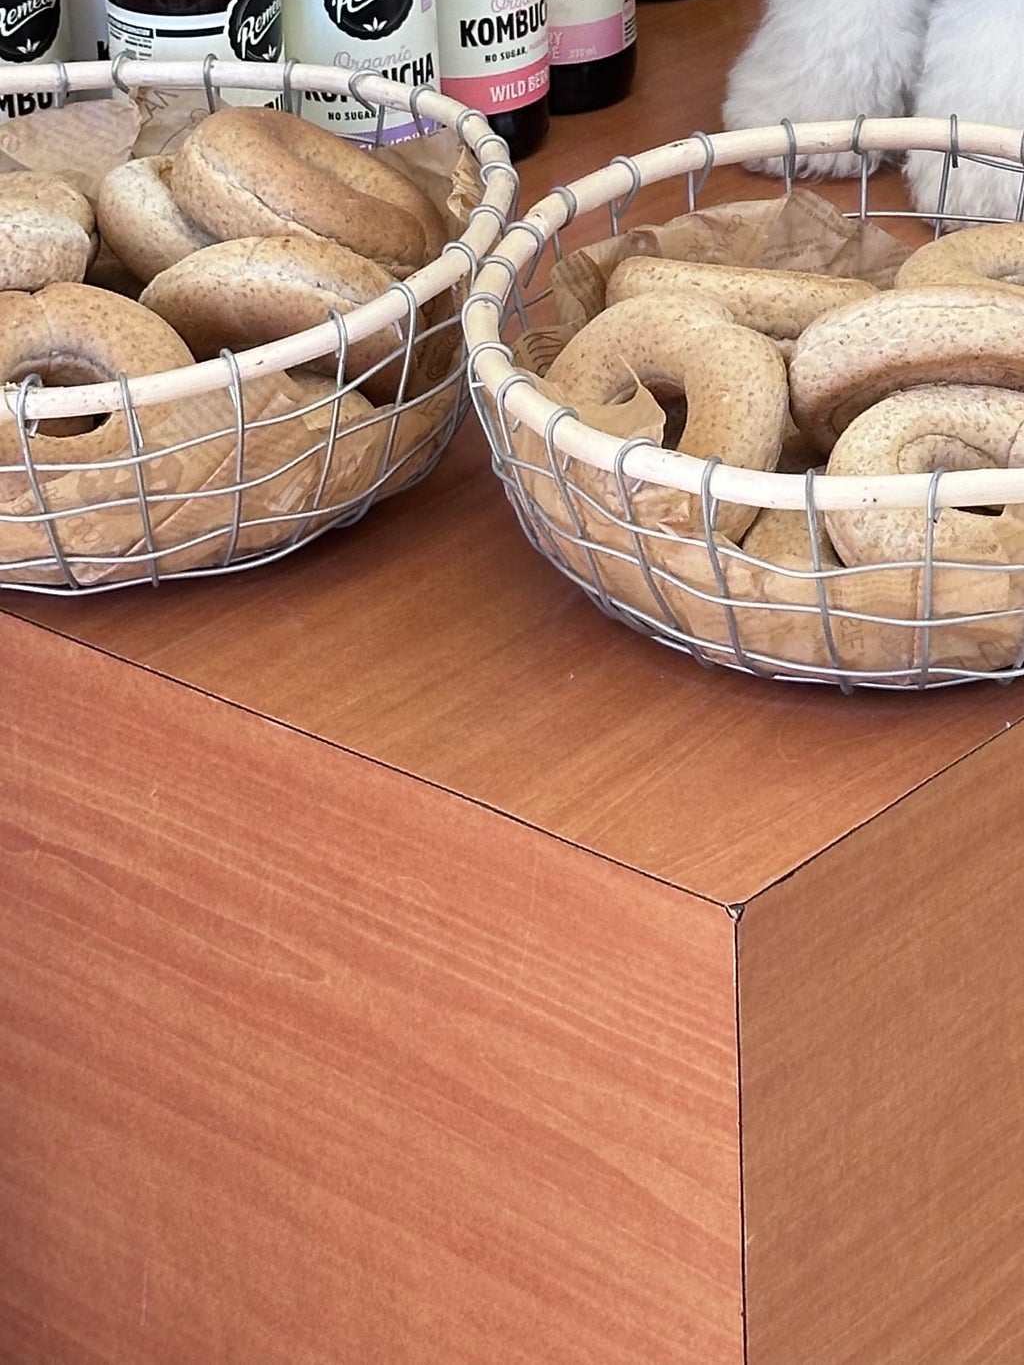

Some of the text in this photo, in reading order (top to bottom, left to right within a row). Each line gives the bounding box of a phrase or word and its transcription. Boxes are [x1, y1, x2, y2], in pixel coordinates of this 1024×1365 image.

[485, 53, 498, 63] NO
[490, 80, 526, 103] WILD
[328, 111, 341, 120] NO
